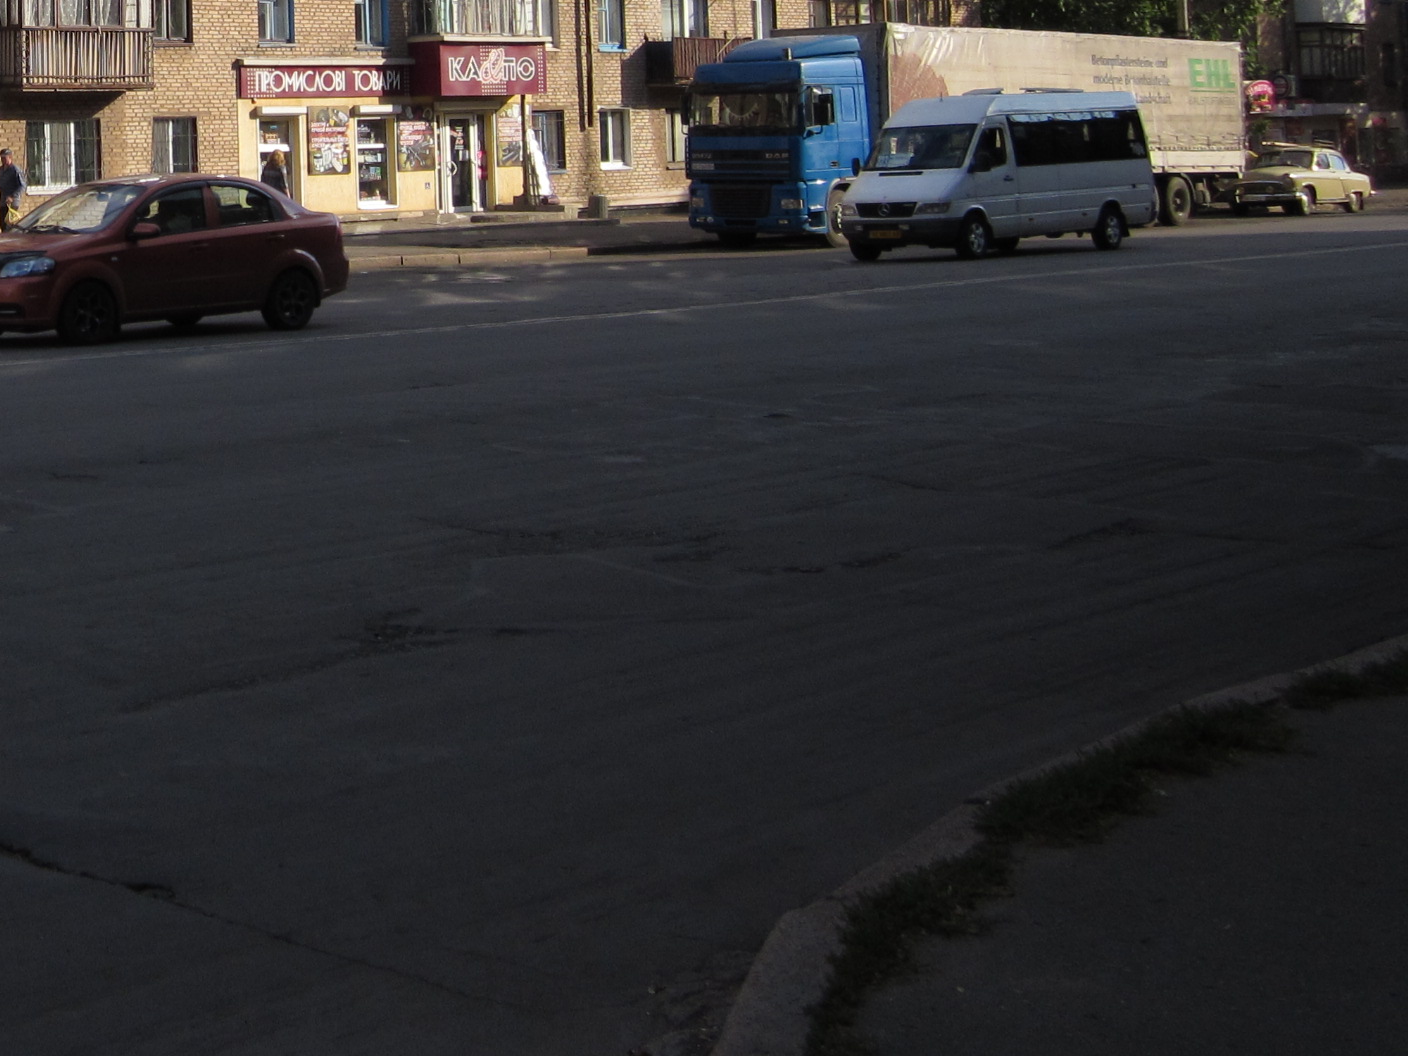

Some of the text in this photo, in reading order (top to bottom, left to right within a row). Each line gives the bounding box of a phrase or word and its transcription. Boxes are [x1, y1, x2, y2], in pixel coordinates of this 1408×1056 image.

[255, 69, 401, 93] ПРОМИСЛОВІ ТОВАРИ
[1189, 58, 1236, 88] EHL
